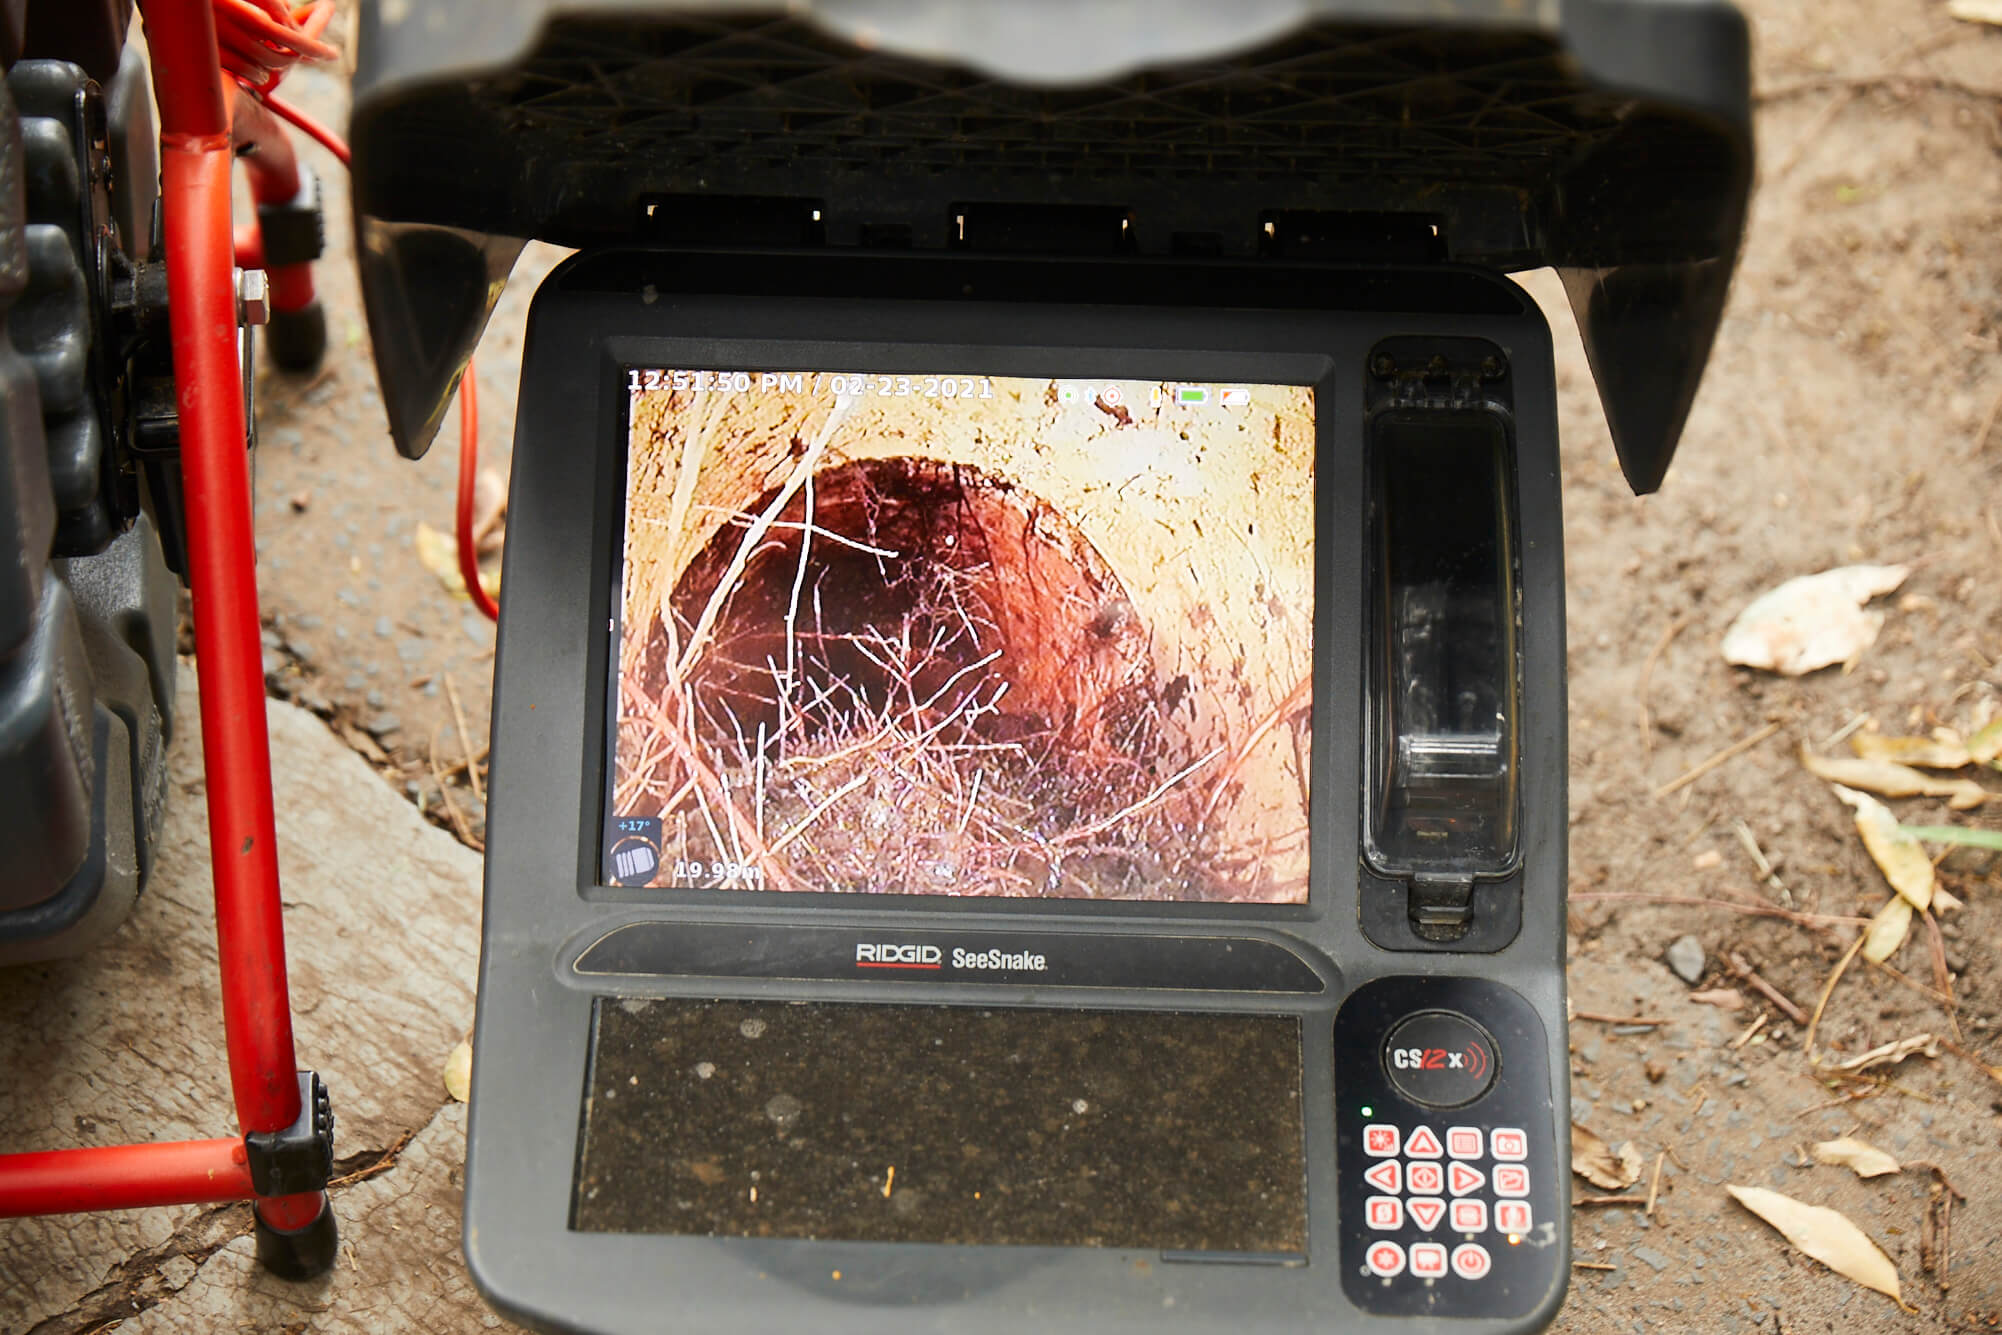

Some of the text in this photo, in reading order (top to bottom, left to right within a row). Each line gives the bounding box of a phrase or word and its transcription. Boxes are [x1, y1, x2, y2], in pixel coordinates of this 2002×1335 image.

[627, 370, 994, 399] 12:51:50 PM / 02-23-2021
[856, 944, 1048, 970] RIDGID SeeSnake
